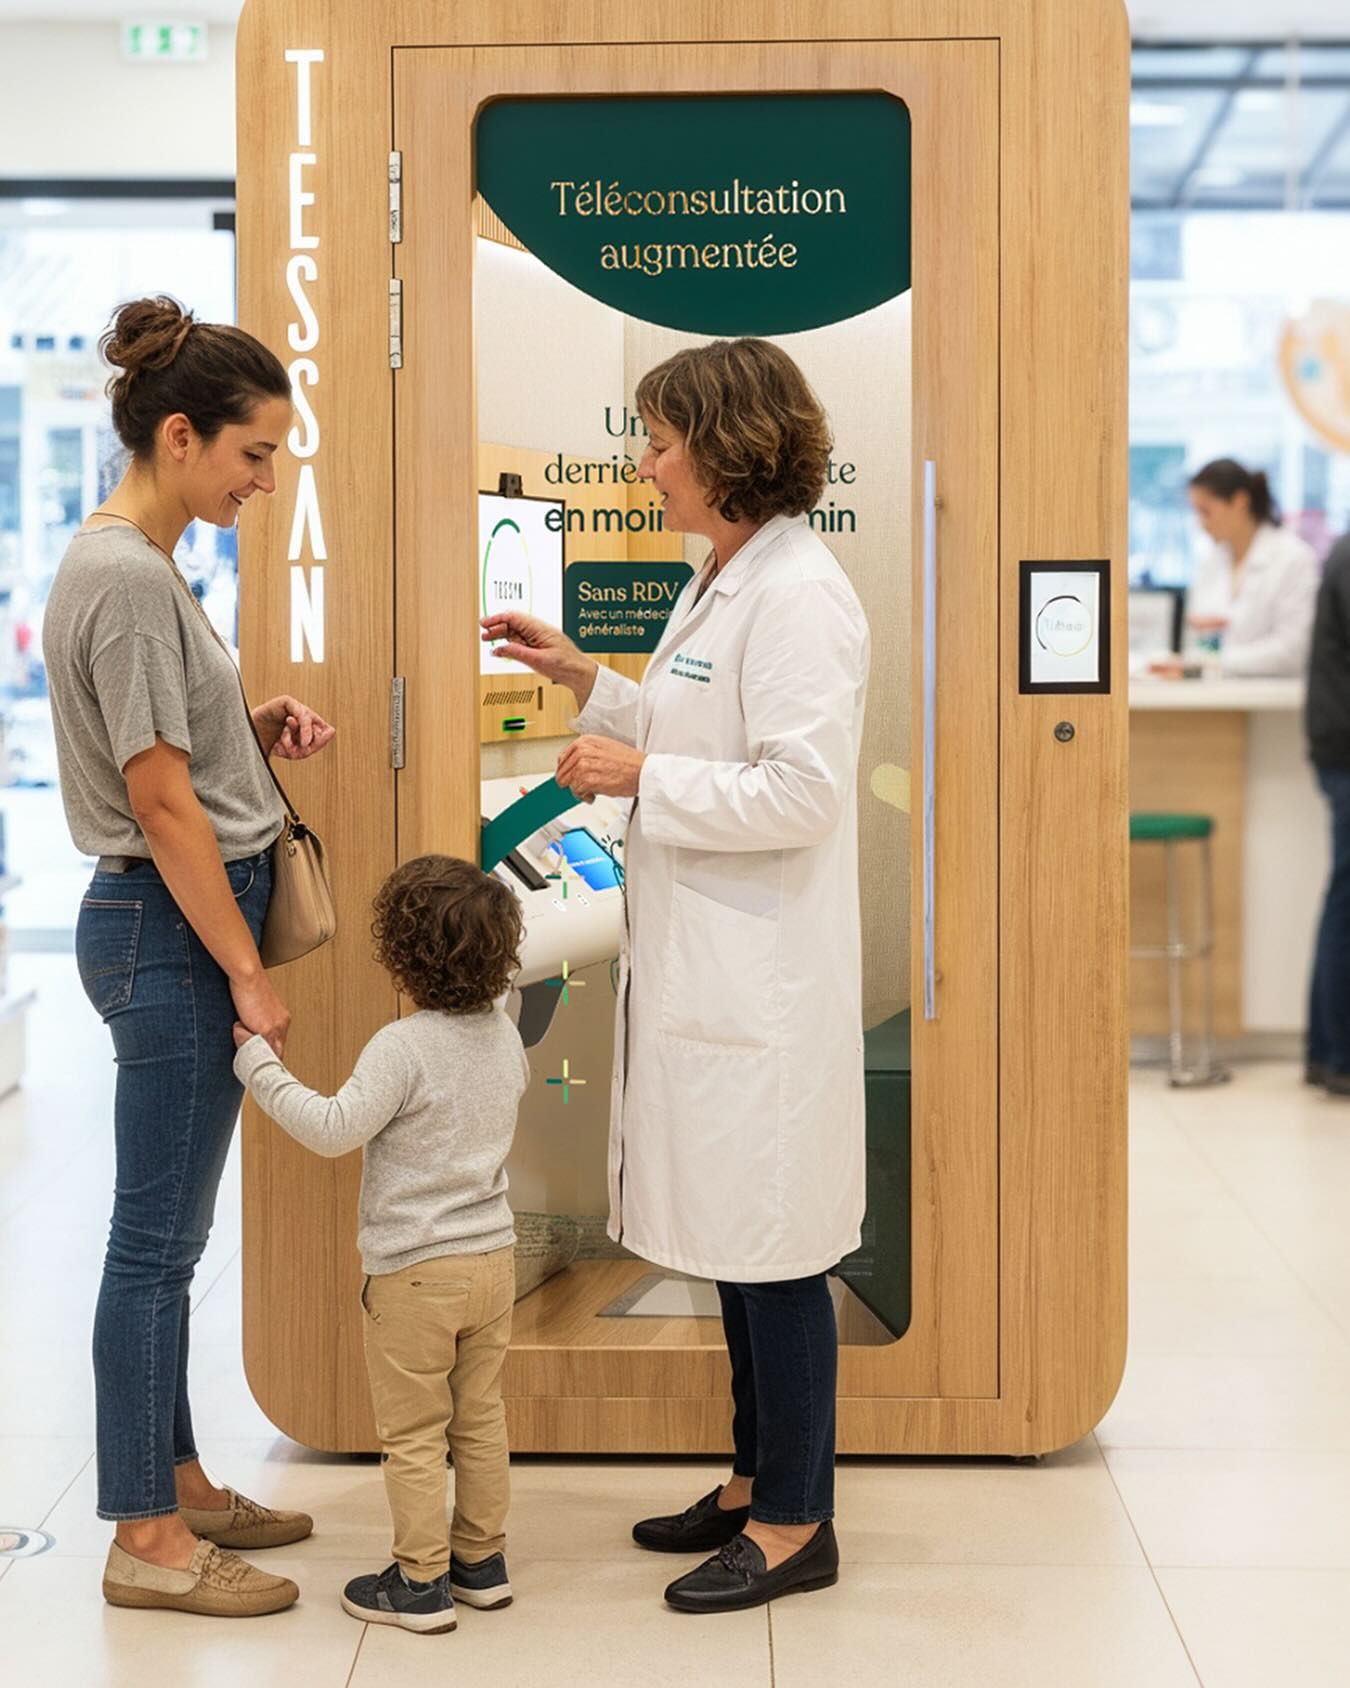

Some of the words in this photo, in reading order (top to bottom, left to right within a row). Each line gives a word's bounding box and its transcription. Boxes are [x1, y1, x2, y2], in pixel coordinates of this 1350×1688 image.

[550, 178, 847, 217] Téléconsultation
[600, 233, 798, 276] augmentée
[285, 49, 327, 663] TESSAN
[544, 453, 647, 485] derriè
[544, 508, 585, 532] en
[578, 580, 628, 602] Sans
[631, 581, 679, 601] RDV
[578, 607, 608, 620] Avec
[608, 609, 624, 620] un
